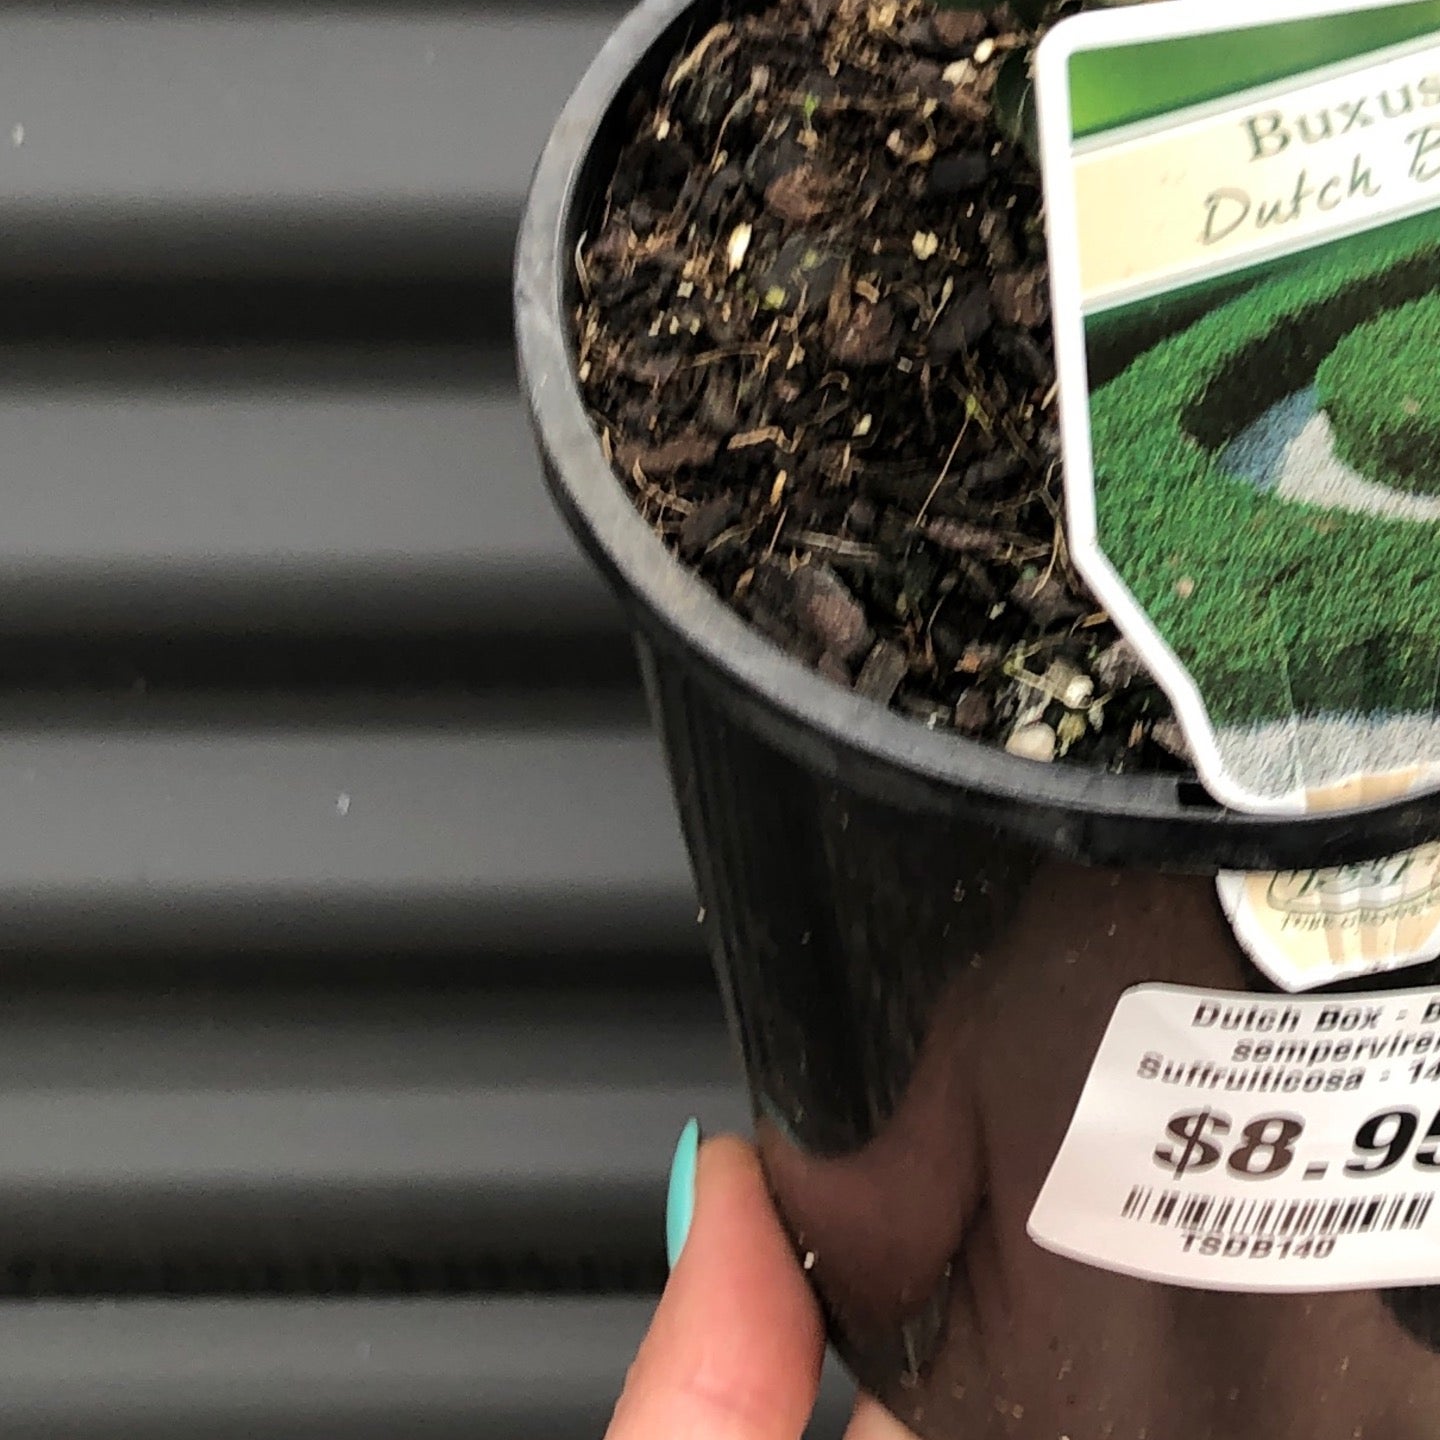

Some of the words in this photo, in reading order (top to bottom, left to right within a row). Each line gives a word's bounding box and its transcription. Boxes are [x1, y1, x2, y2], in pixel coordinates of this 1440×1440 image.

[1196, 154, 1382, 247] Dutch
[1191, 999, 1301, 1033] Dutch
[1313, 1002, 1384, 1033] Box
[1181, 1229, 1338, 1261] TSDB140
